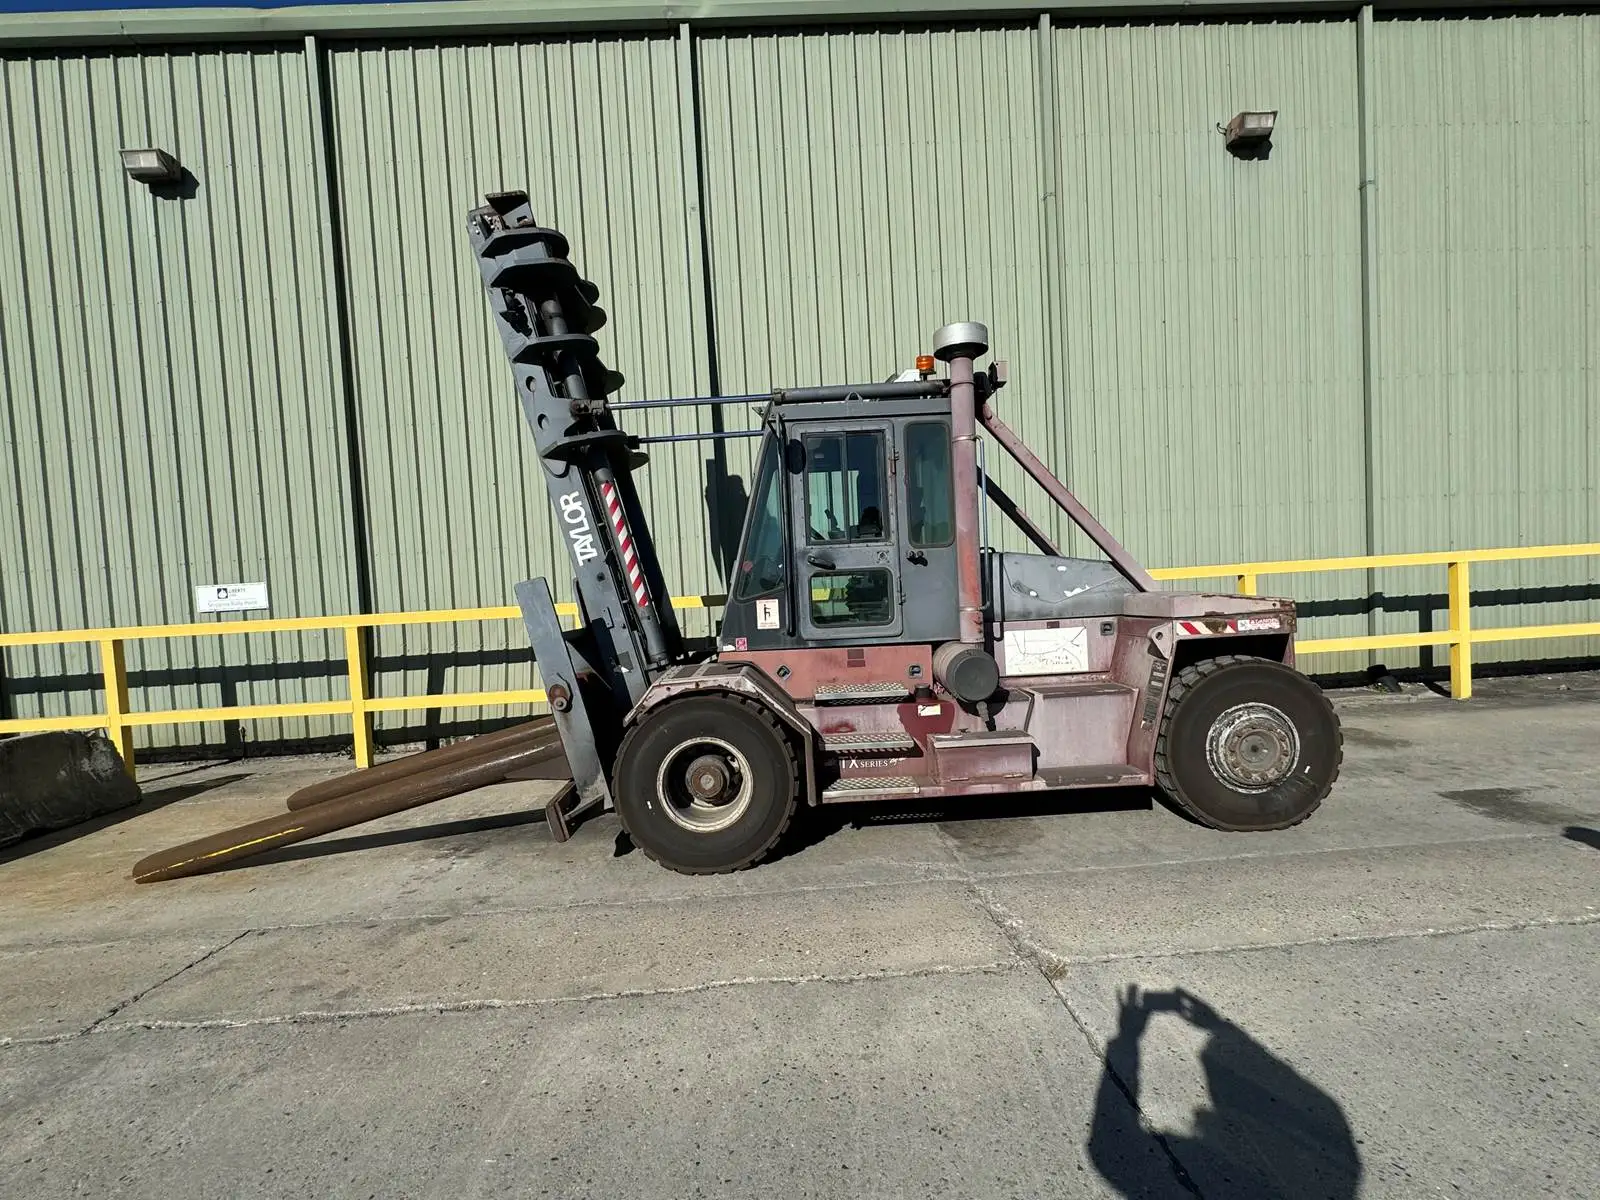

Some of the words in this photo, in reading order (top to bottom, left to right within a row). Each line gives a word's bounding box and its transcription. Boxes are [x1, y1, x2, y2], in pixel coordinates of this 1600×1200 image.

[559, 490, 598, 567] TAYLOR
[838, 756, 859, 769] TX
[860, 760, 889, 769] SERIES
